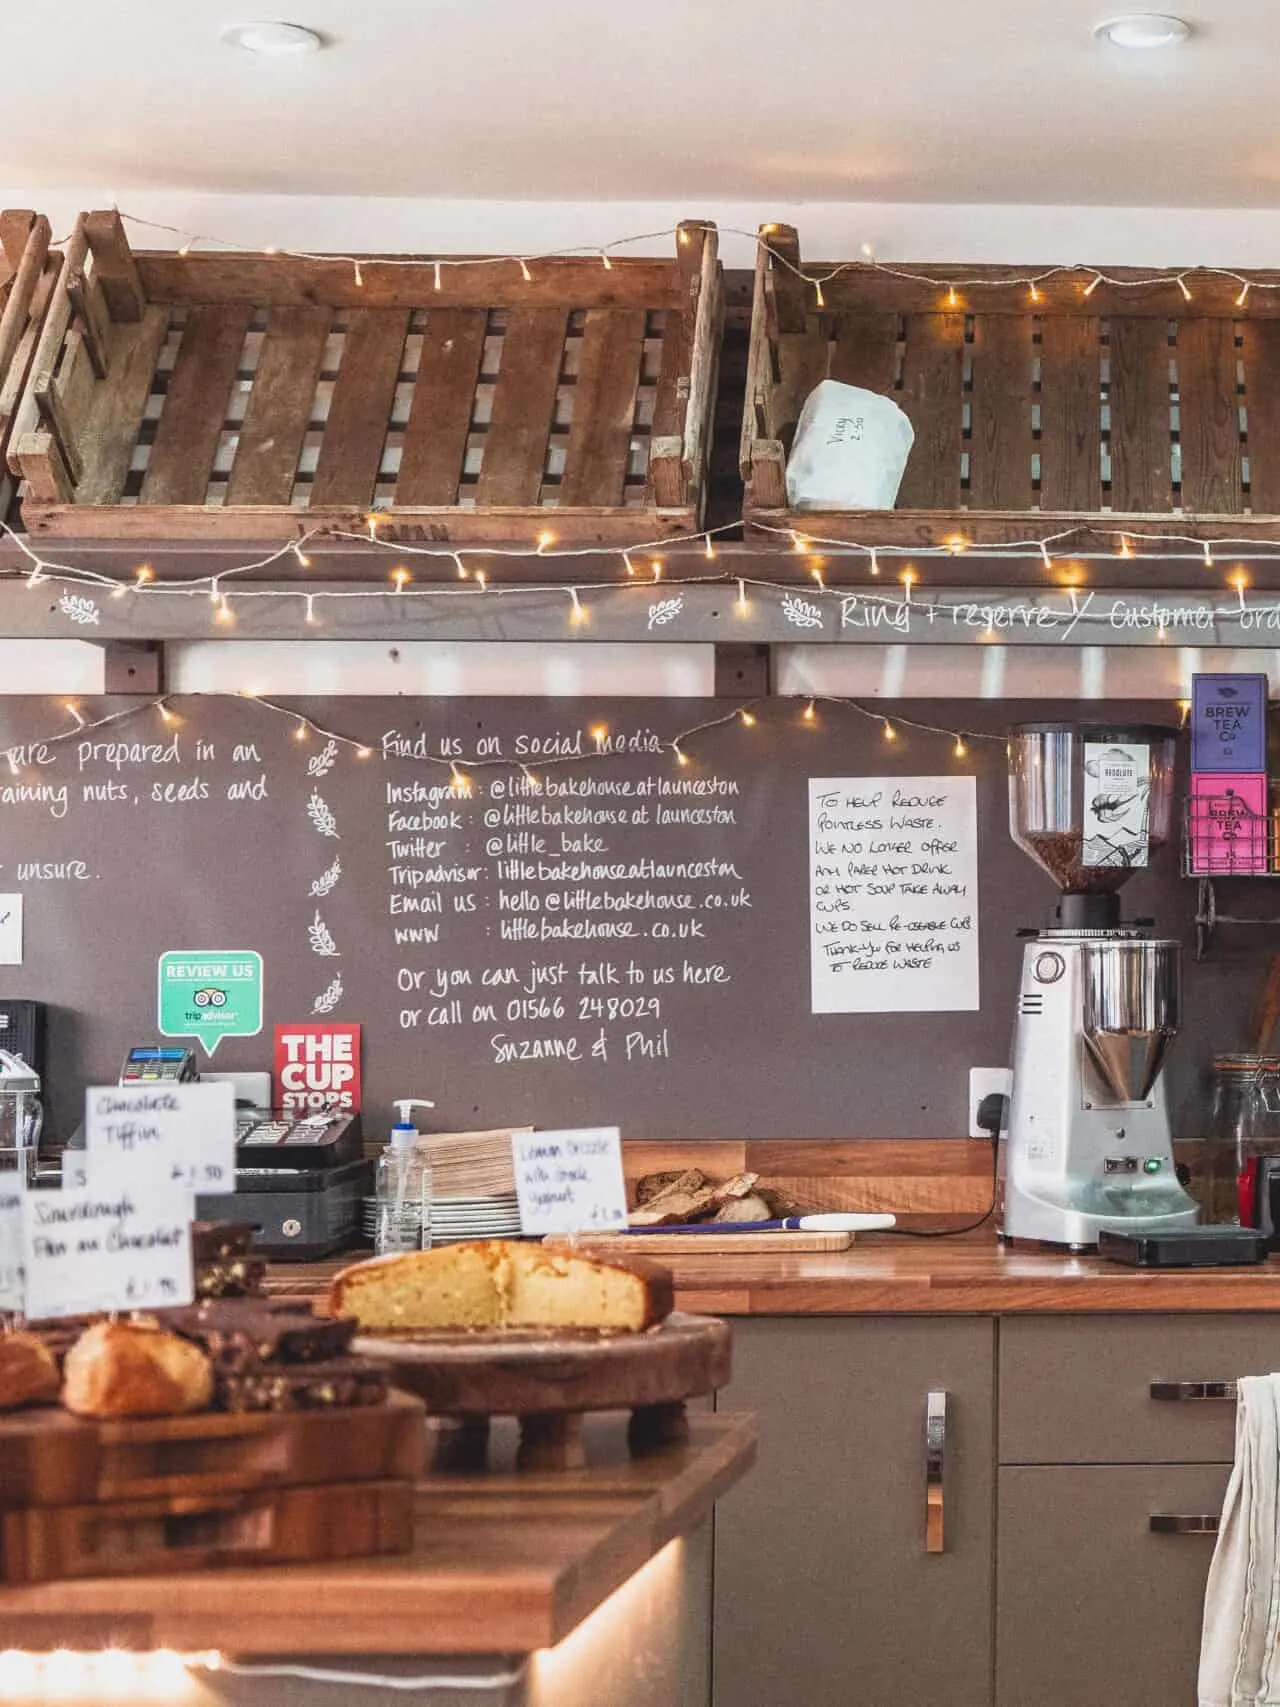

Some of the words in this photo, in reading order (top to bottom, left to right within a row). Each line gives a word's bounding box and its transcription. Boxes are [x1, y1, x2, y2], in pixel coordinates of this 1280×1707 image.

[841, 597, 910, 632] Ring
[951, 603, 1056, 628] reserve
[1205, 707, 1249, 718] BREW
[1213, 720, 1242, 730] TEA
[78, 733, 181, 771] prepared
[196, 739, 215, 762] in
[232, 743, 262, 763] an
[382, 730, 426, 760] Find
[440, 737, 463, 755] us
[476, 736, 502, 755] on
[515, 730, 582, 755] social
[595, 729, 664, 754] media
[0, 784, 68, 818] aining
[84, 780, 138, 805] nuts,
[152, 777, 209, 801] seeds
[228, 774, 269, 801] and
[816, 791, 840, 808] TO
[846, 791, 882, 808] HELP
[892, 789, 947, 807] REDUCE
[388, 811, 463, 832] Facebook
[386, 838, 447, 858] Twitter
[816, 841, 836, 854] WE
[842, 843, 862, 854] NO
[883, 863, 907, 875] HOT
[836, 884, 861, 895] HOT
[867, 882, 895, 895] SOUP
[900, 882, 928, 895] TAKE
[390, 891, 442, 914] Email
[454, 894, 476, 912] us
[816, 921, 838, 933] WE
[842, 920, 857, 931] DO
[862, 920, 886, 931] SELL
[166, 964, 227, 977] REVIEW
[232, 964, 253, 977] US
[397, 968, 426, 992] Or
[430, 968, 472, 997] you
[482, 968, 520, 986] can
[524, 961, 568, 993] just
[577, 962, 620, 985] talk
[626, 960, 645, 984] to
[653, 968, 675, 985] us
[682, 960, 731, 984] here
[400, 1009, 422, 1028] or
[428, 1000, 462, 1025] call
[472, 1004, 497, 1023] on
[507, 996, 565, 1021] 01566
[579, 997, 661, 1020] 248029
[281, 1034, 352, 1061] THE
[491, 1033, 583, 1064] Suzanne
[626, 1028, 669, 1061] Phil
[281, 1063, 354, 1090] CUP
[282, 1091, 353, 1109] STOPS
